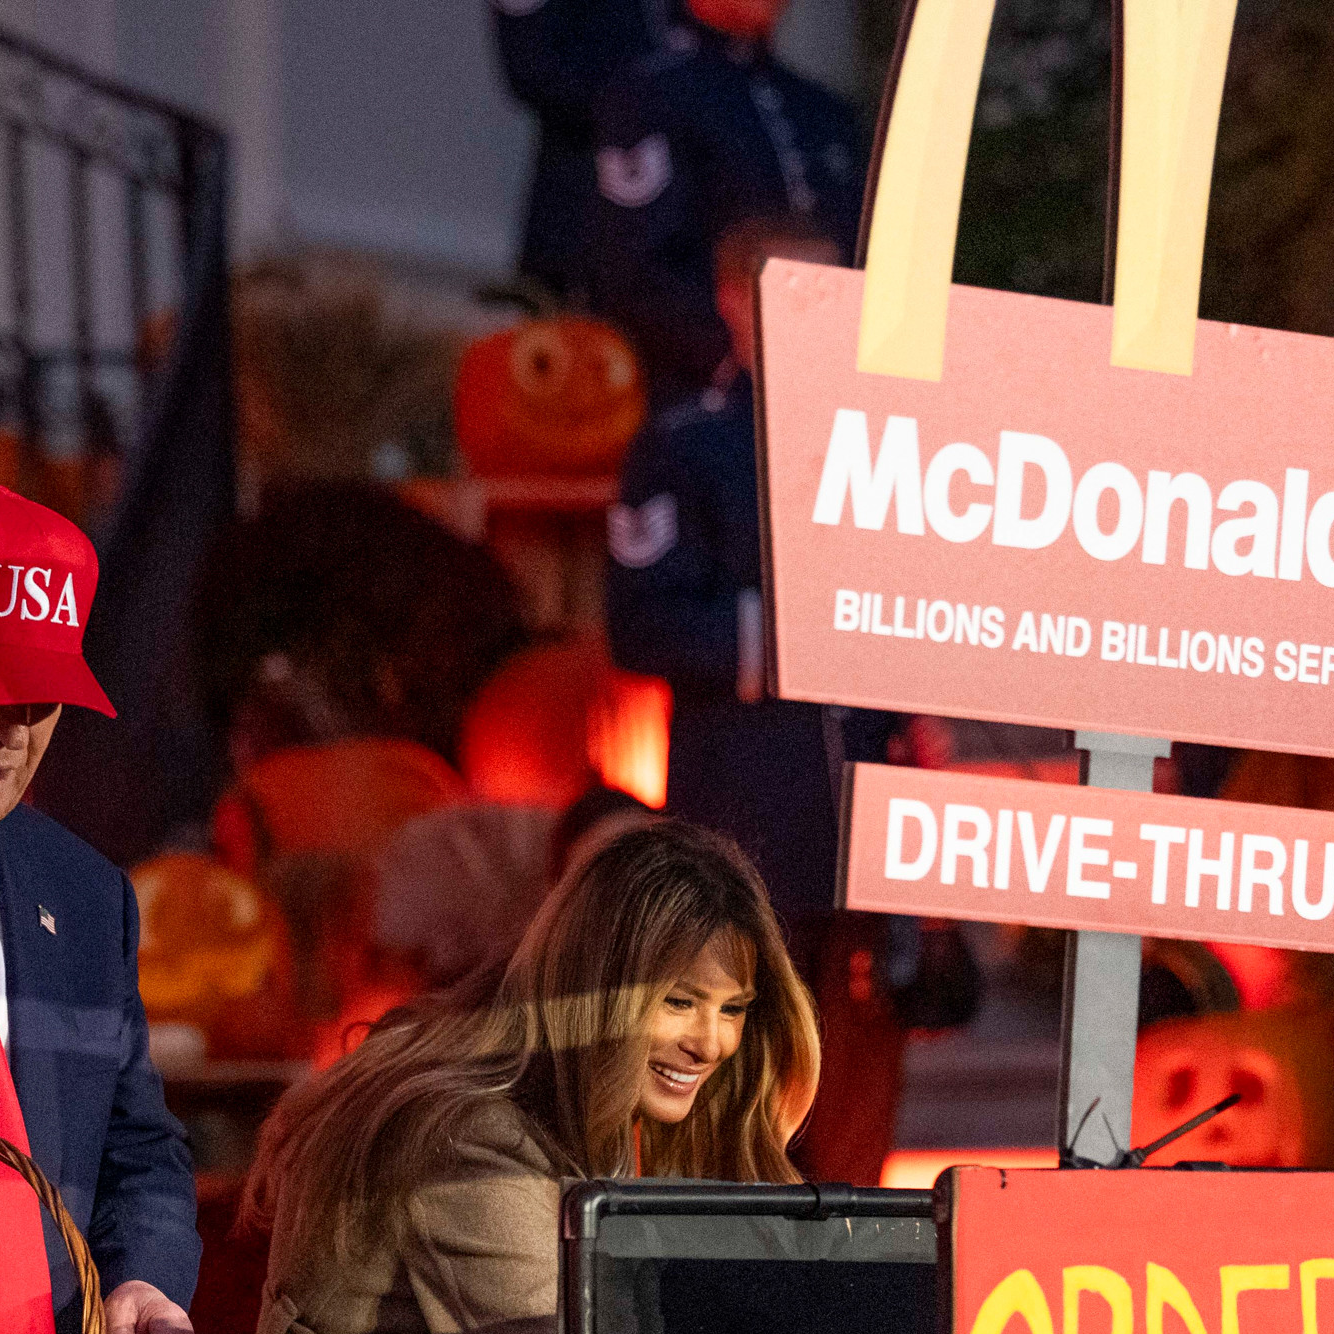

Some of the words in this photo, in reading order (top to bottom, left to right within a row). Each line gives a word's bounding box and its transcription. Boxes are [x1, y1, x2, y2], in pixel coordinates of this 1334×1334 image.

[833, 589, 1005, 649] BILLIONS
[1012, 611, 1092, 659] AND
[1100, 620, 1265, 680] BILLIONS
